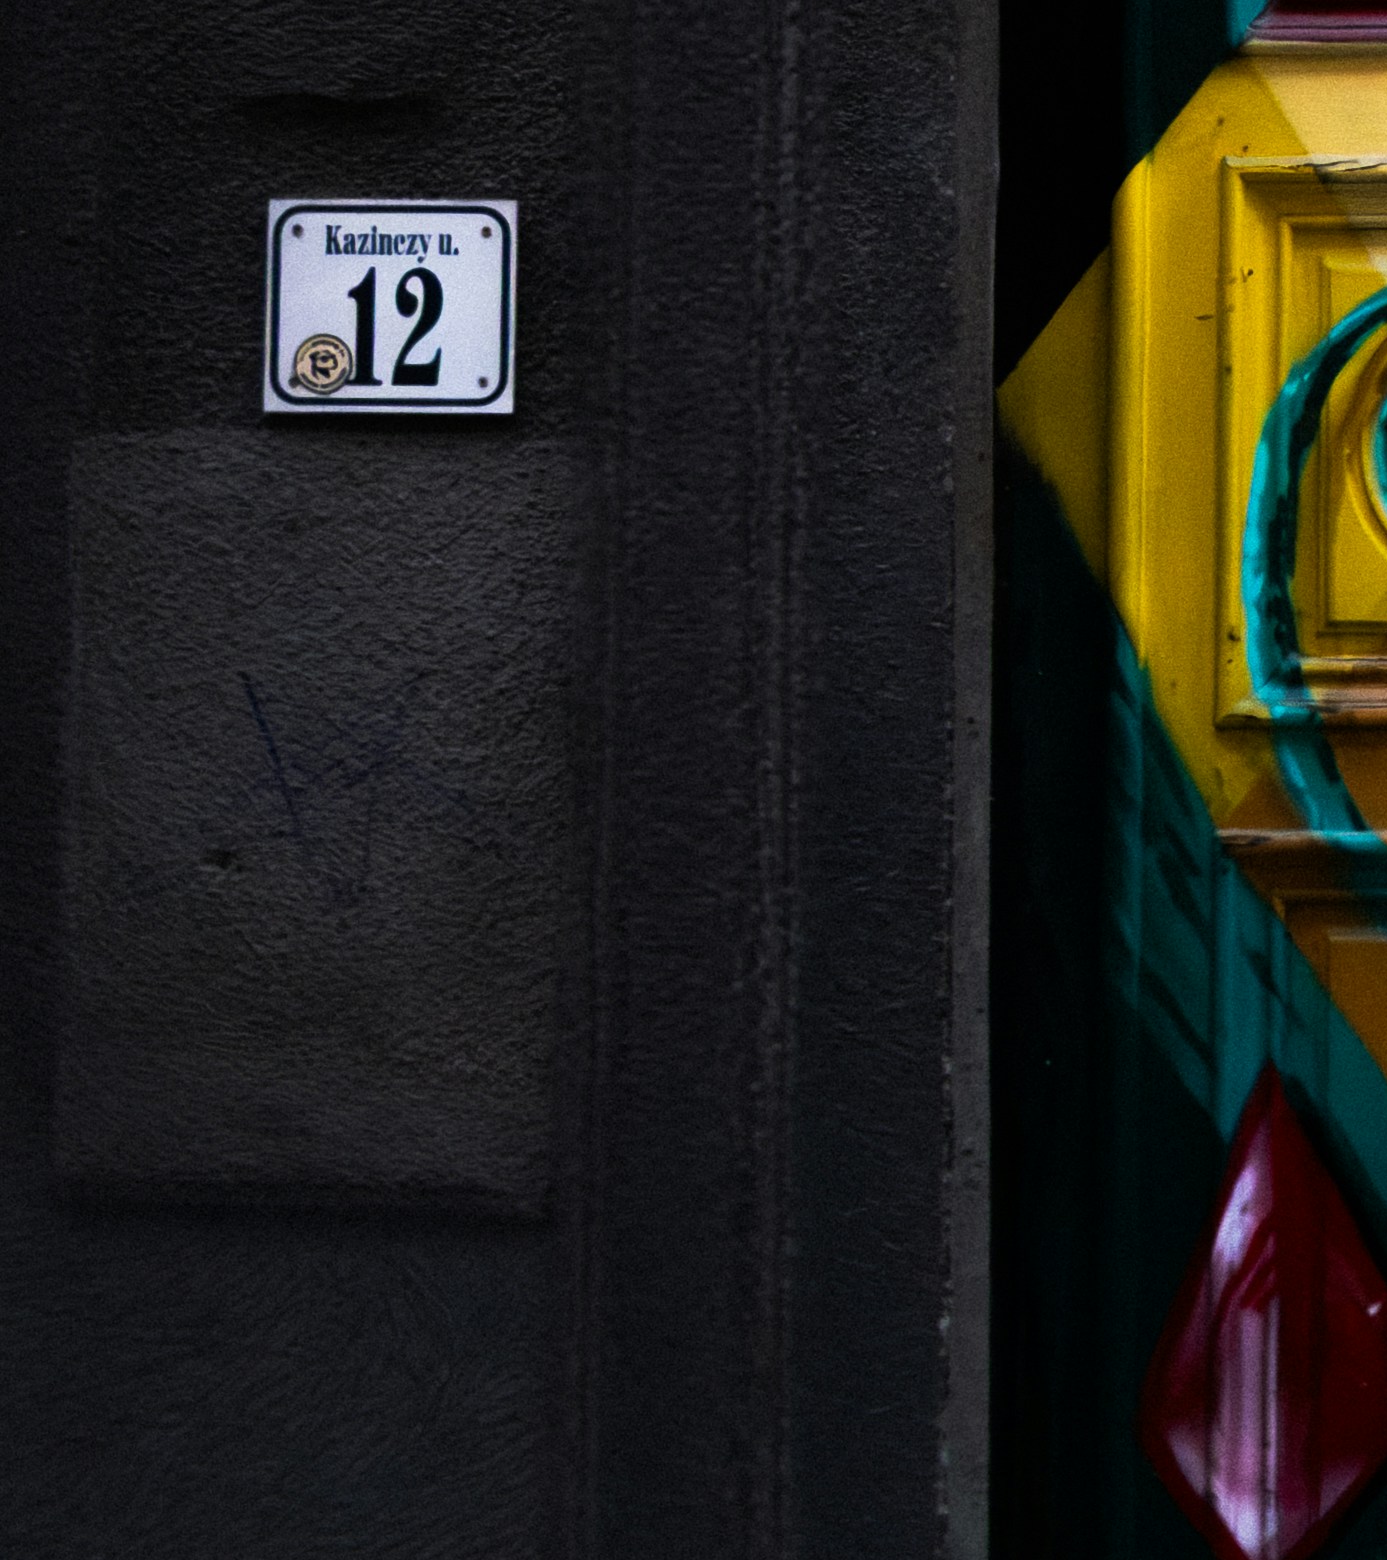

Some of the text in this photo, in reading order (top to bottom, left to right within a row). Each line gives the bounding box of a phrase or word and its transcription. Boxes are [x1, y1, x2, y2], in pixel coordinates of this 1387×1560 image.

[325, 225, 459, 263] Kazinczy u.
[346, 266, 443, 386] 12
